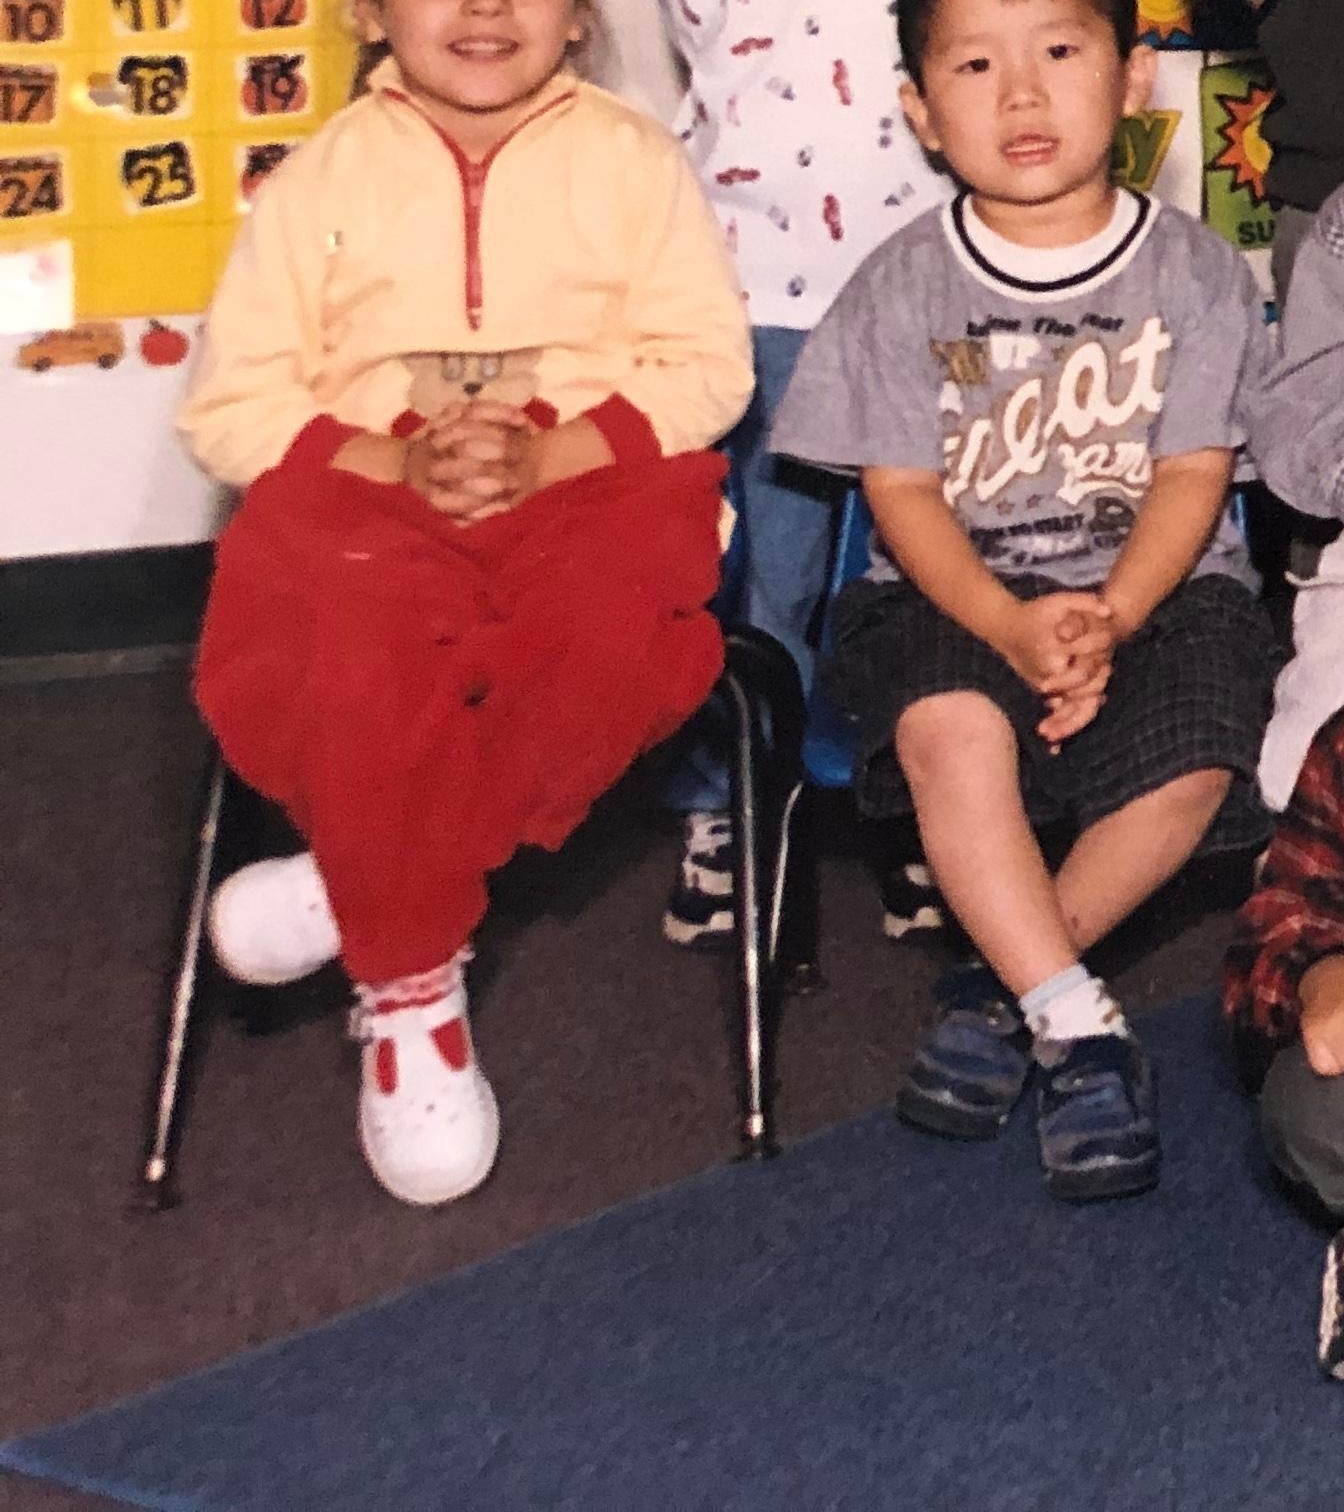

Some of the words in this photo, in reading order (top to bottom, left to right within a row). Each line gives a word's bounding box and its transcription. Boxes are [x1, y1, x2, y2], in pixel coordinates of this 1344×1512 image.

[4, 2, 53, 41] 10
[133, 74, 181, 115] 18
[253, 80, 293, 116] 19
[0, 175, 61, 218] 24
[134, 159, 197, 208] 25
